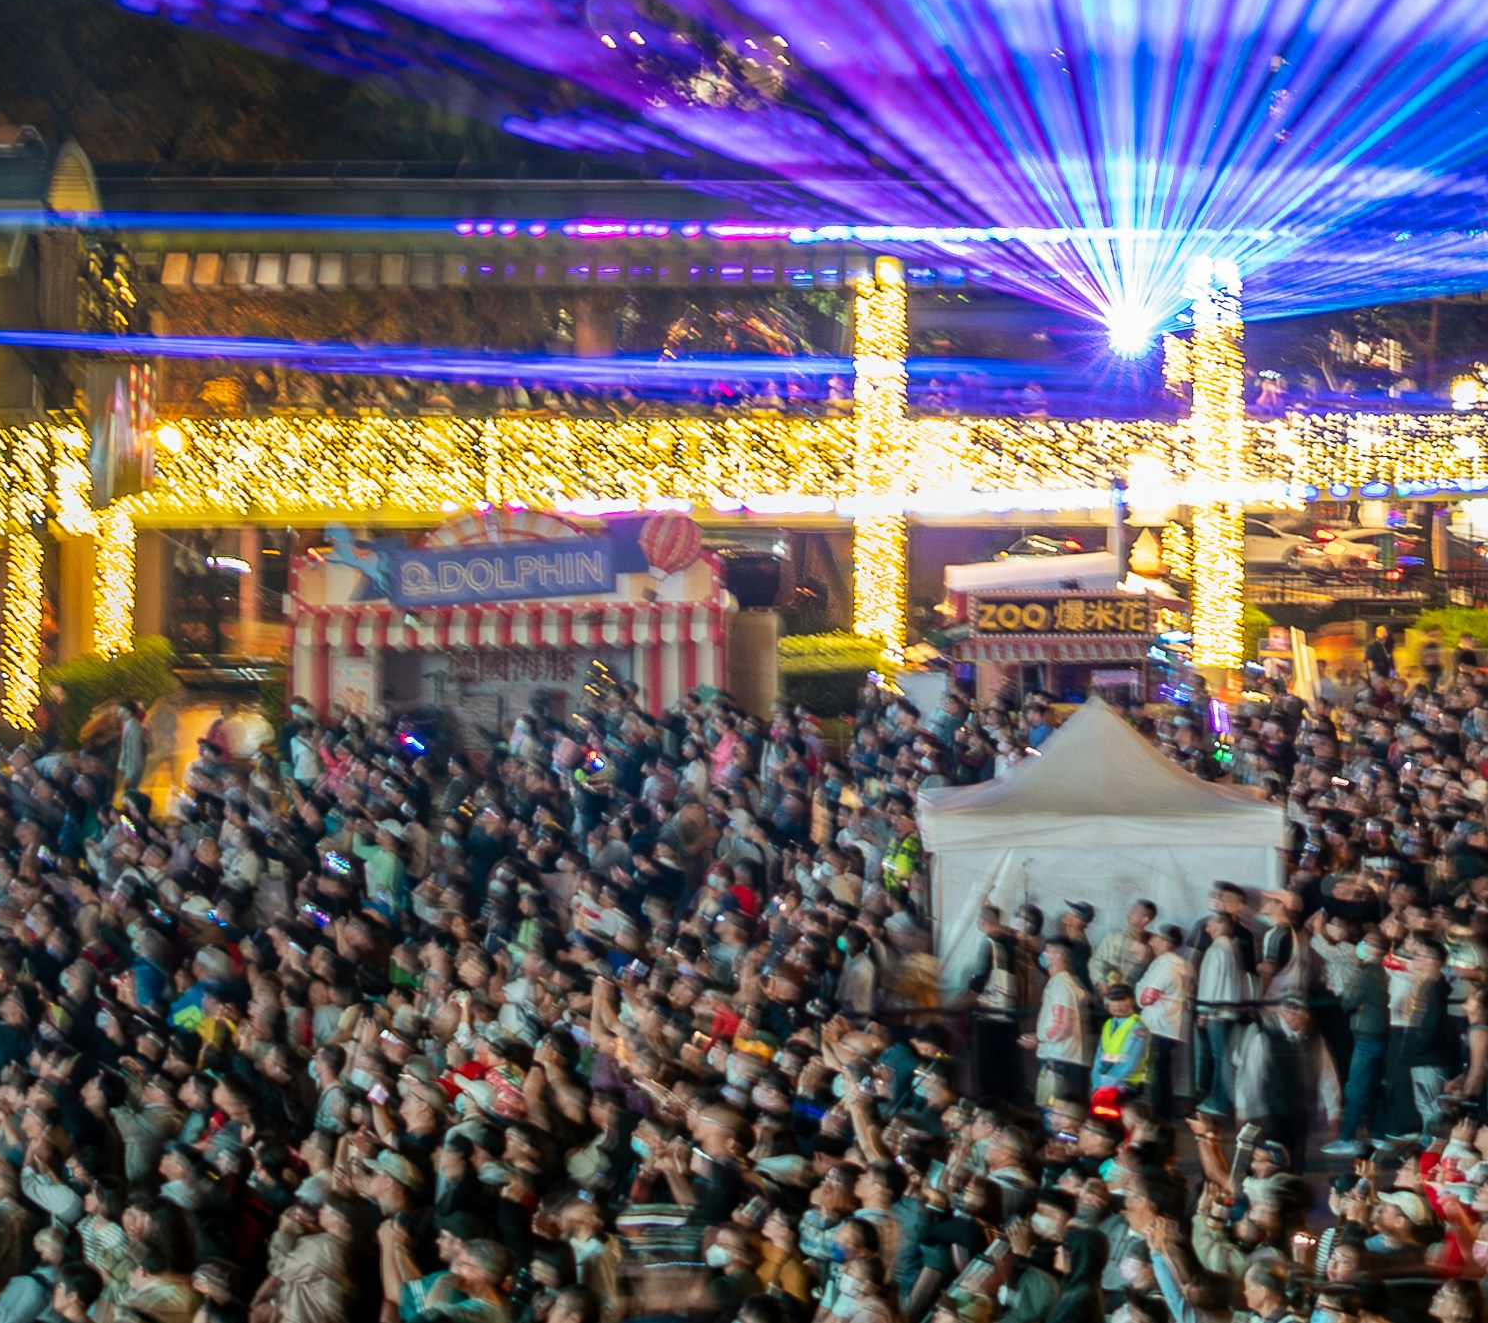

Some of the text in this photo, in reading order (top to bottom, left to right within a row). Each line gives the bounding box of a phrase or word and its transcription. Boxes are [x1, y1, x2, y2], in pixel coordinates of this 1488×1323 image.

[436, 551, 605, 592] DOLPHIN
[979, 598, 1148, 632] ZOO 爆米花
